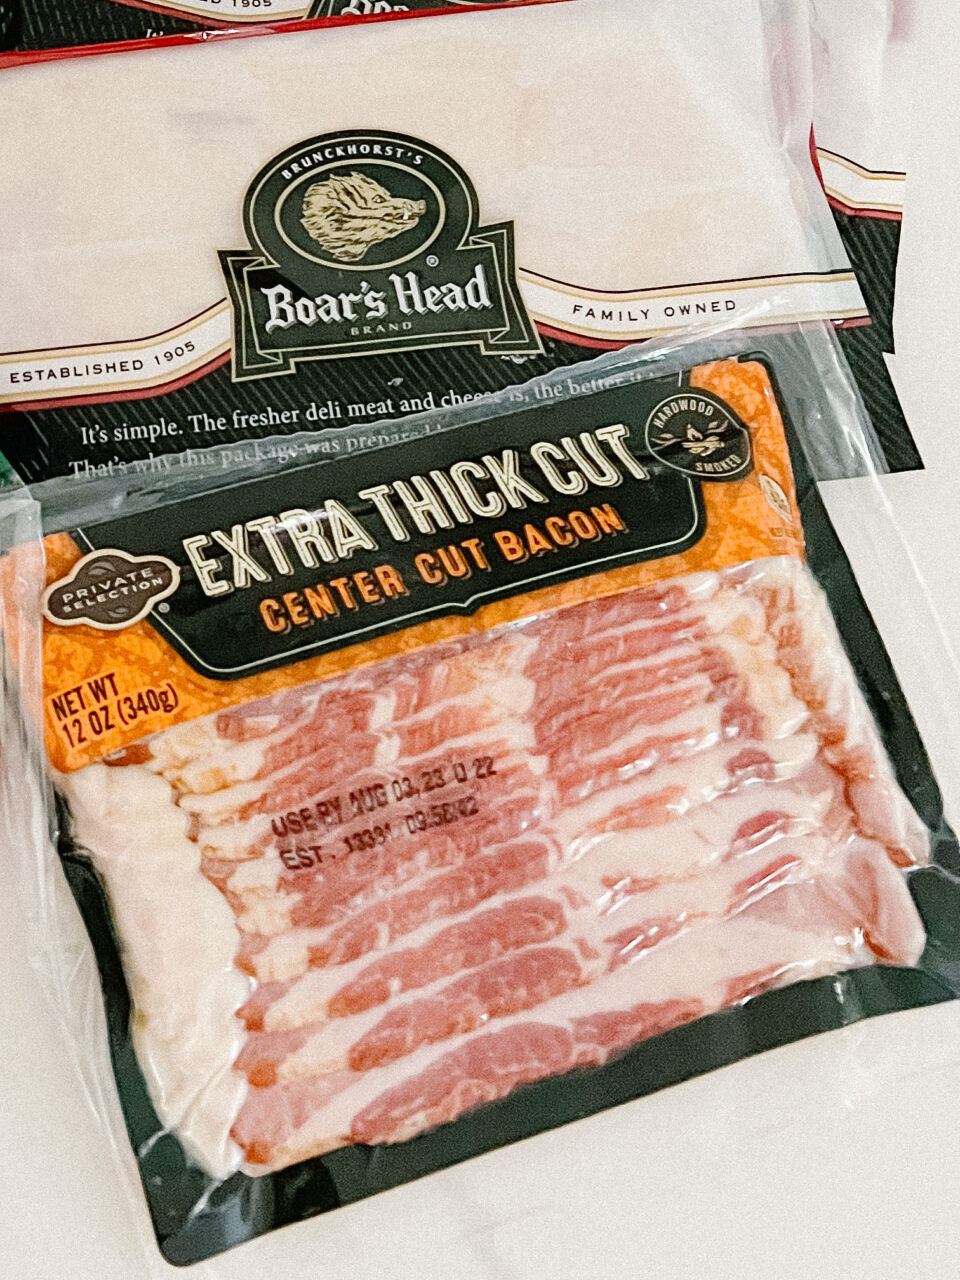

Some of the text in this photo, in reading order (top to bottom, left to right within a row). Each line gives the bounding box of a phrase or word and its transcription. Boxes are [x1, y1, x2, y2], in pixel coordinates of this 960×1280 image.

[281, 144, 425, 181] BRUNCKHORST'S
[260, 264, 493, 336] Boar's Head
[573, 298, 738, 322] FAMILY OWNED
[350, 321, 413, 336] BRAND
[9, 341, 196, 384] ESTABLISHED 1905
[80, 426, 110, 446] It's
[113, 417, 183, 446] simple.
[187, 412, 227, 434] The
[233, 405, 300, 429] fresher
[305, 400, 342, 423] deli
[347, 397, 396, 417] meat
[399, 392, 436, 413] and
[509, 389, 529, 403] is,
[534, 383, 563, 400] the
[567, 378, 624, 396] better
[652, 398, 715, 429] HARDWOOD
[68, 438, 341, 480] That's why this package was
[695, 453, 742, 473] SMOKED
[183, 422, 654, 599] EXTRA THICK CUT
[62, 567, 154, 603] PRIVATE
[257, 502, 630, 637] CENTER CUT BACON
[62, 576, 164, 613] SELECTION
[52, 672, 119, 721] NET WT
[62, 683, 179, 748] 12 OZ (340g)
[271, 808, 319, 838] USE
[349, 783, 389, 818] AUG
[472, 756, 498, 779] 22
